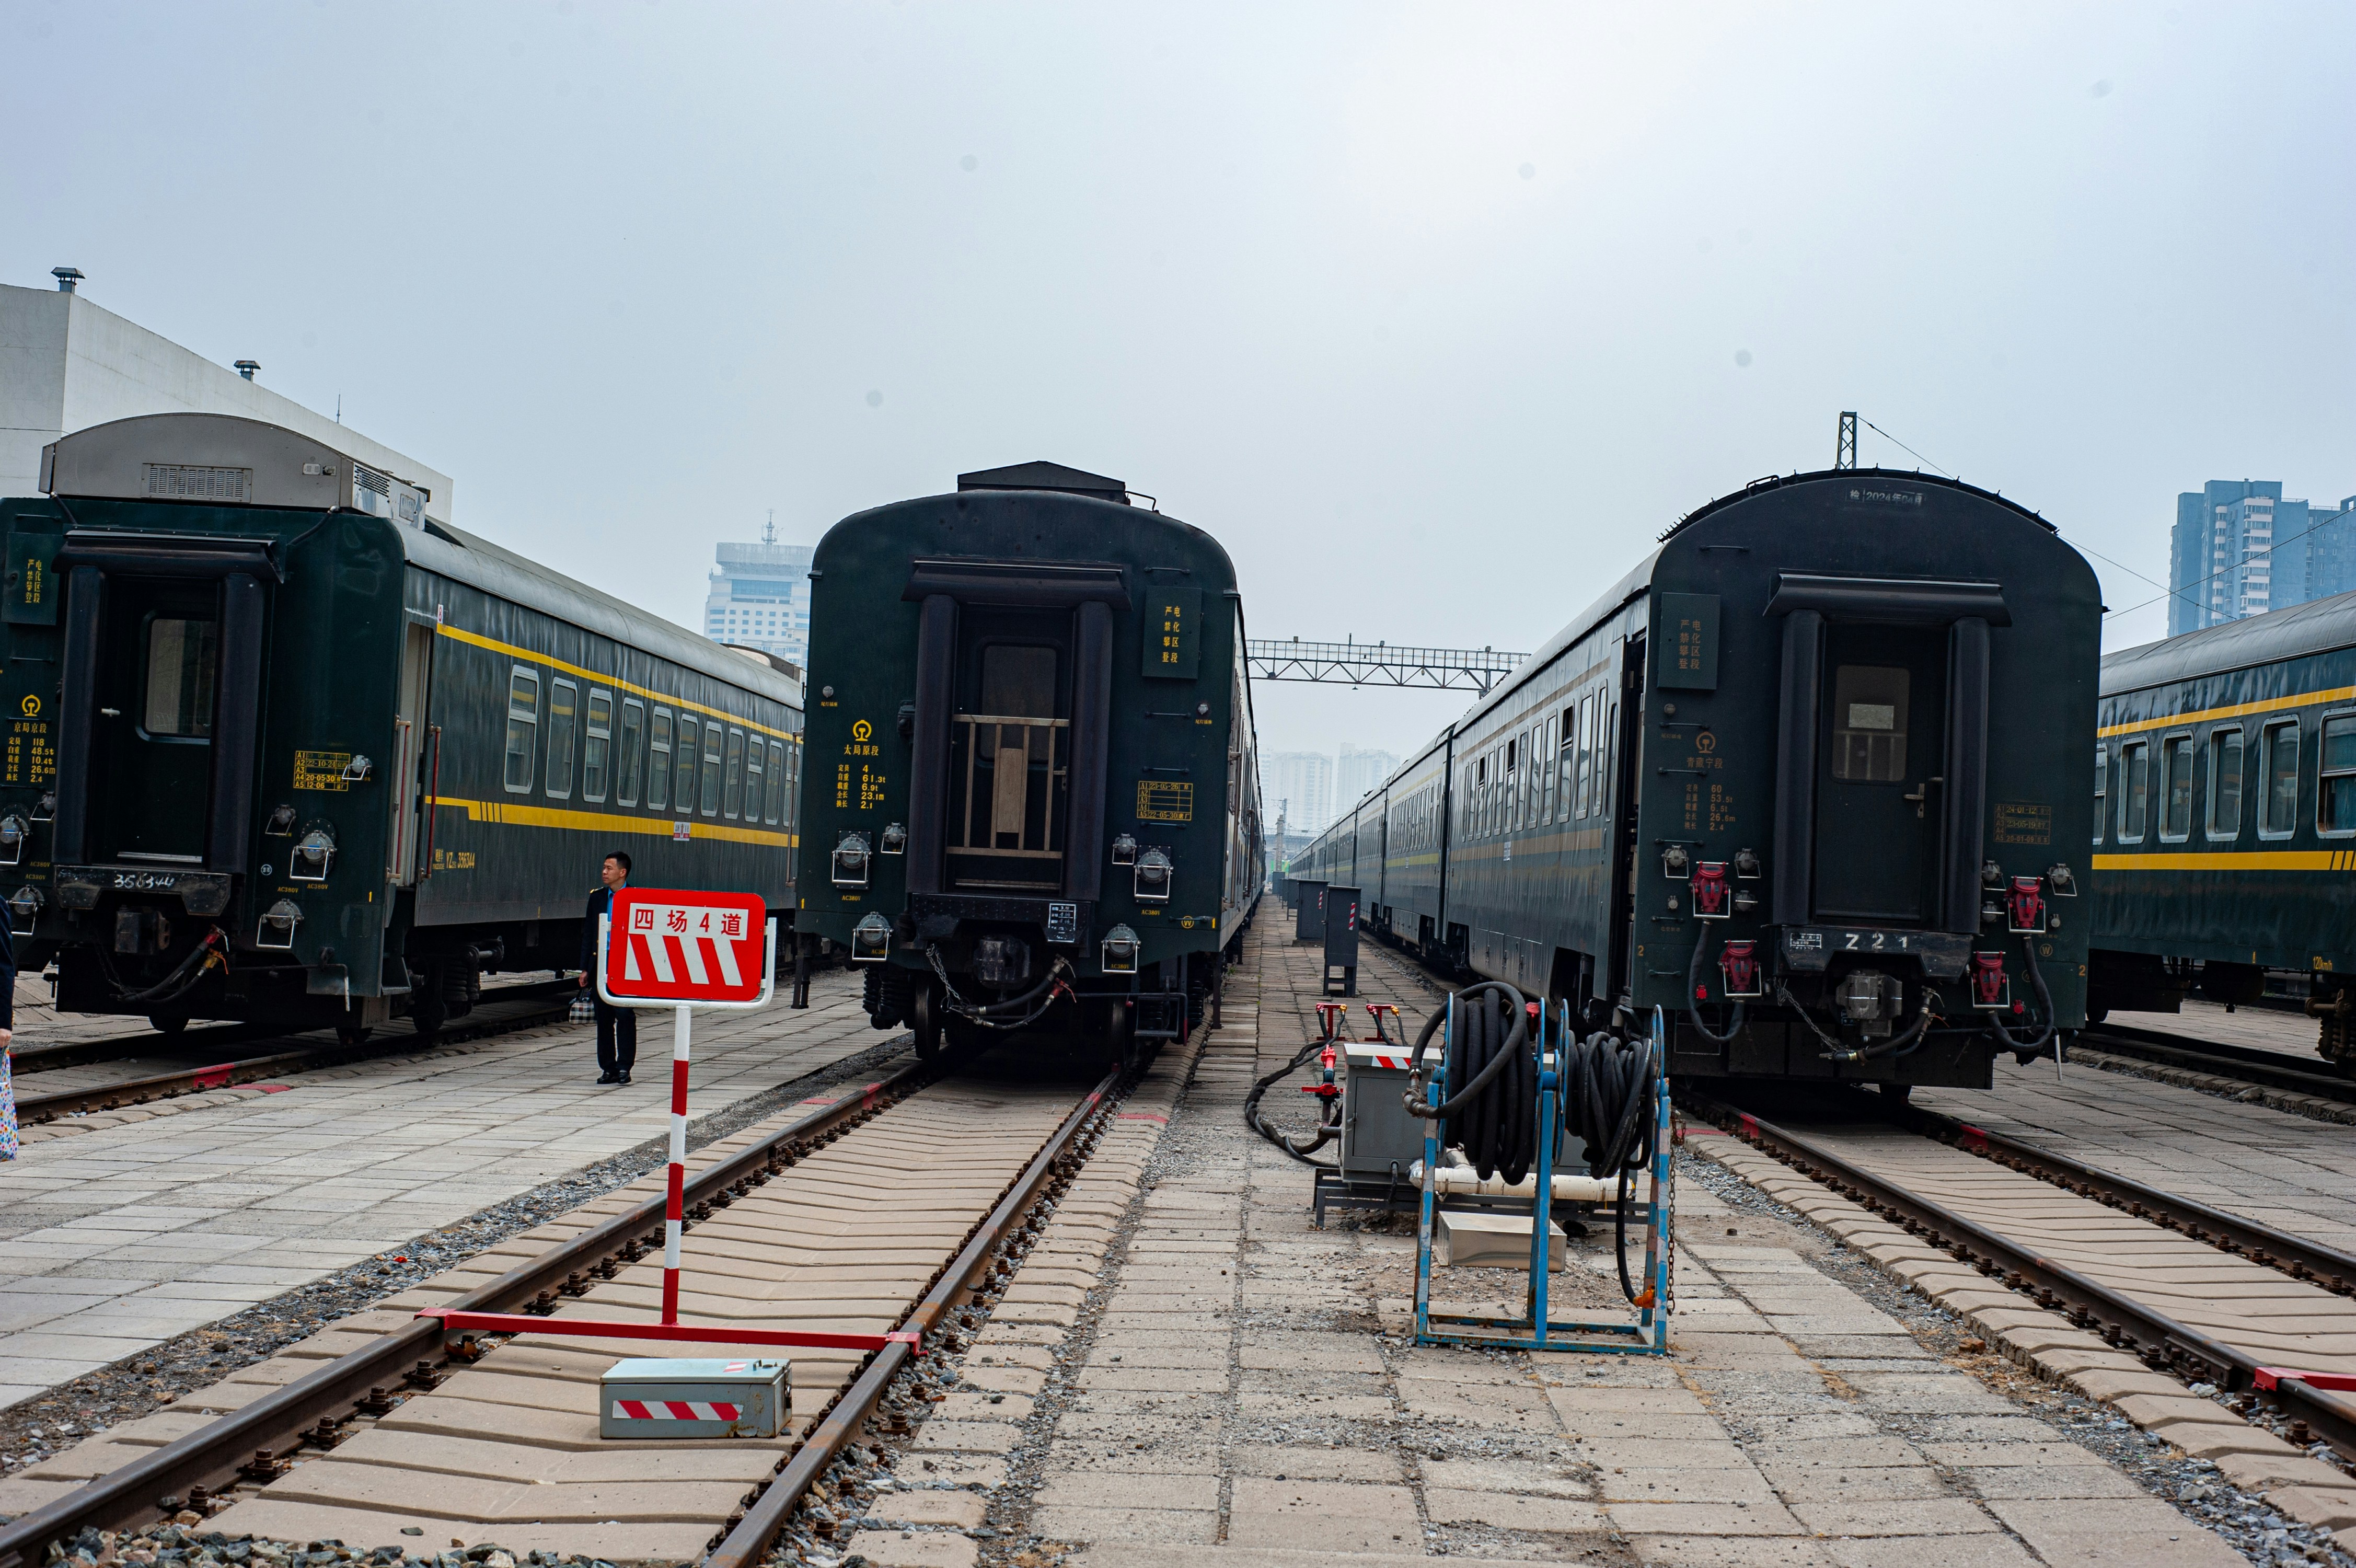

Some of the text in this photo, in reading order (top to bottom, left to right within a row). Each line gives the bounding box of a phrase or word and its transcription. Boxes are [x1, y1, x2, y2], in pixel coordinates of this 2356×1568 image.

[1162, 606, 1172, 662] 严禁攀登
[1170, 606, 1180, 663] 电化区段
[1679, 619, 1689, 669] 严禁攀登
[1690, 619, 1701, 669] 电化区段
[33, 738, 44, 746] 118
[31, 747, 54, 755] 48.5t
[844, 744, 879, 756] 太局原段
[31, 756, 53, 765] 10.4t
[31, 765, 56, 775] 26.6m
[862, 775, 886, 783] 61.3t
[862, 783, 878, 791] 6.9t
[1711, 785, 1722, 793] 60
[861, 792, 884, 800] 23.1m
[1711, 794, 1733, 803] 53.5t
[861, 801, 872, 809] 2.1
[1710, 804, 1728, 812] 6.5t
[1710, 813, 1736, 822] 26.6m
[1710, 822, 1724, 831] 2.4
[368, 891, 372, 902] 1
[801, 898, 805, 909] 1
[634, 909, 742, 936] 四场4道
[1212, 917, 1216, 928] 1
[1637, 945, 1644, 956] 2
[2078, 965, 2086, 976] 2
